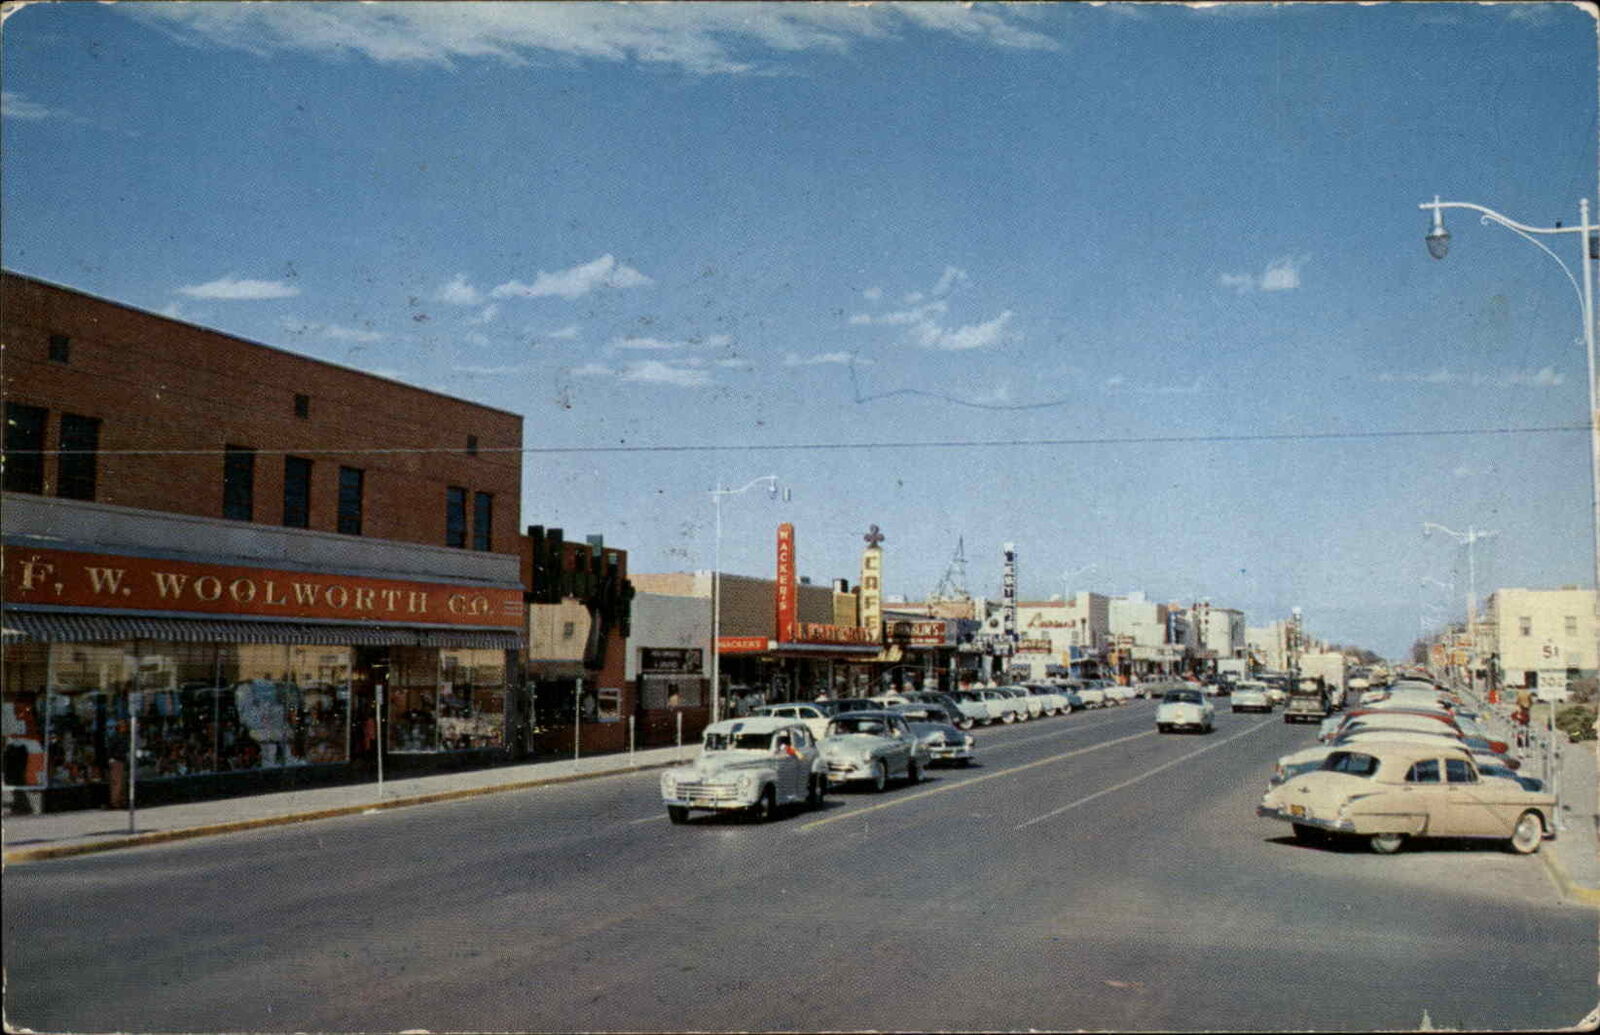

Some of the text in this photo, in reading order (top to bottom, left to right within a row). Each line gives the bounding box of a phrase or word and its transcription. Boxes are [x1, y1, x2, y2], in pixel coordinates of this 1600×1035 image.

[85, 566, 131, 596] W.
[152, 570, 428, 614] WOOLWORTH
[779, 531, 788, 610] WACKER'S
[864, 556, 879, 630] CAFE
